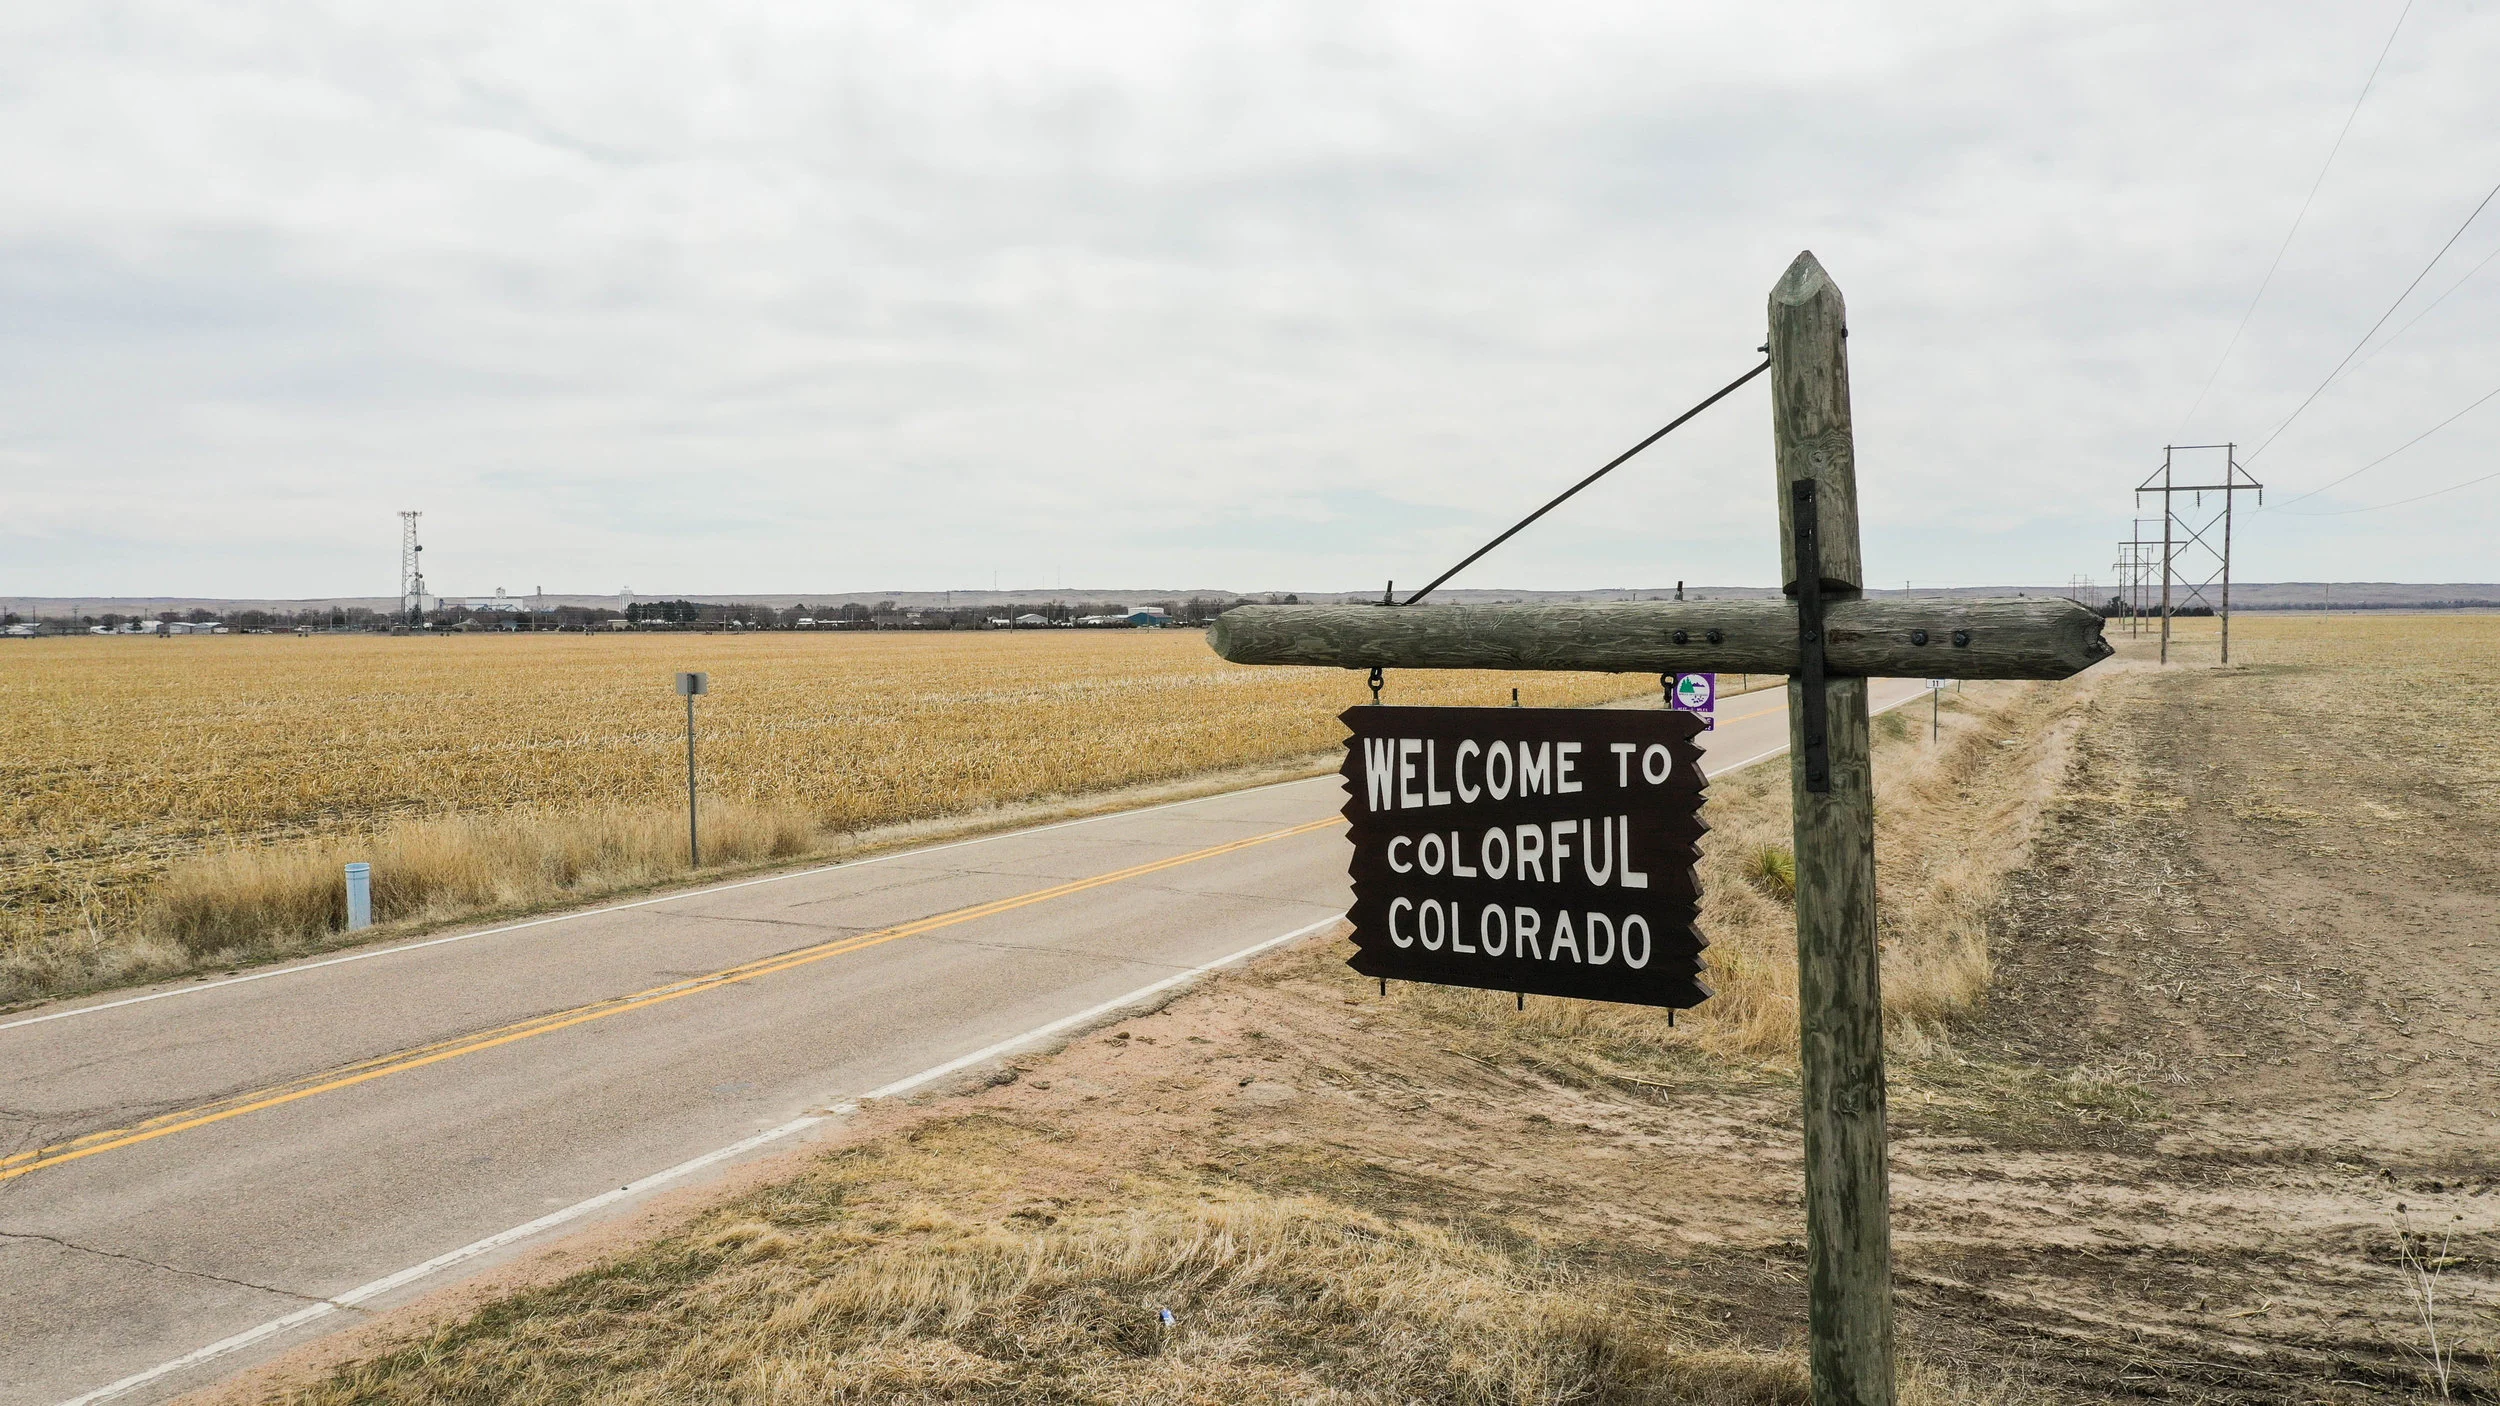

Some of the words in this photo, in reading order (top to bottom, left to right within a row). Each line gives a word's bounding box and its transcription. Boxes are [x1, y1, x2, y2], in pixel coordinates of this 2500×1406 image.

[1363, 737, 1583, 812] WELCOME
[1610, 742, 1672, 788] TO
[1387, 814, 1648, 889] COLORFUL
[1388, 896, 1651, 970] COLORADO
